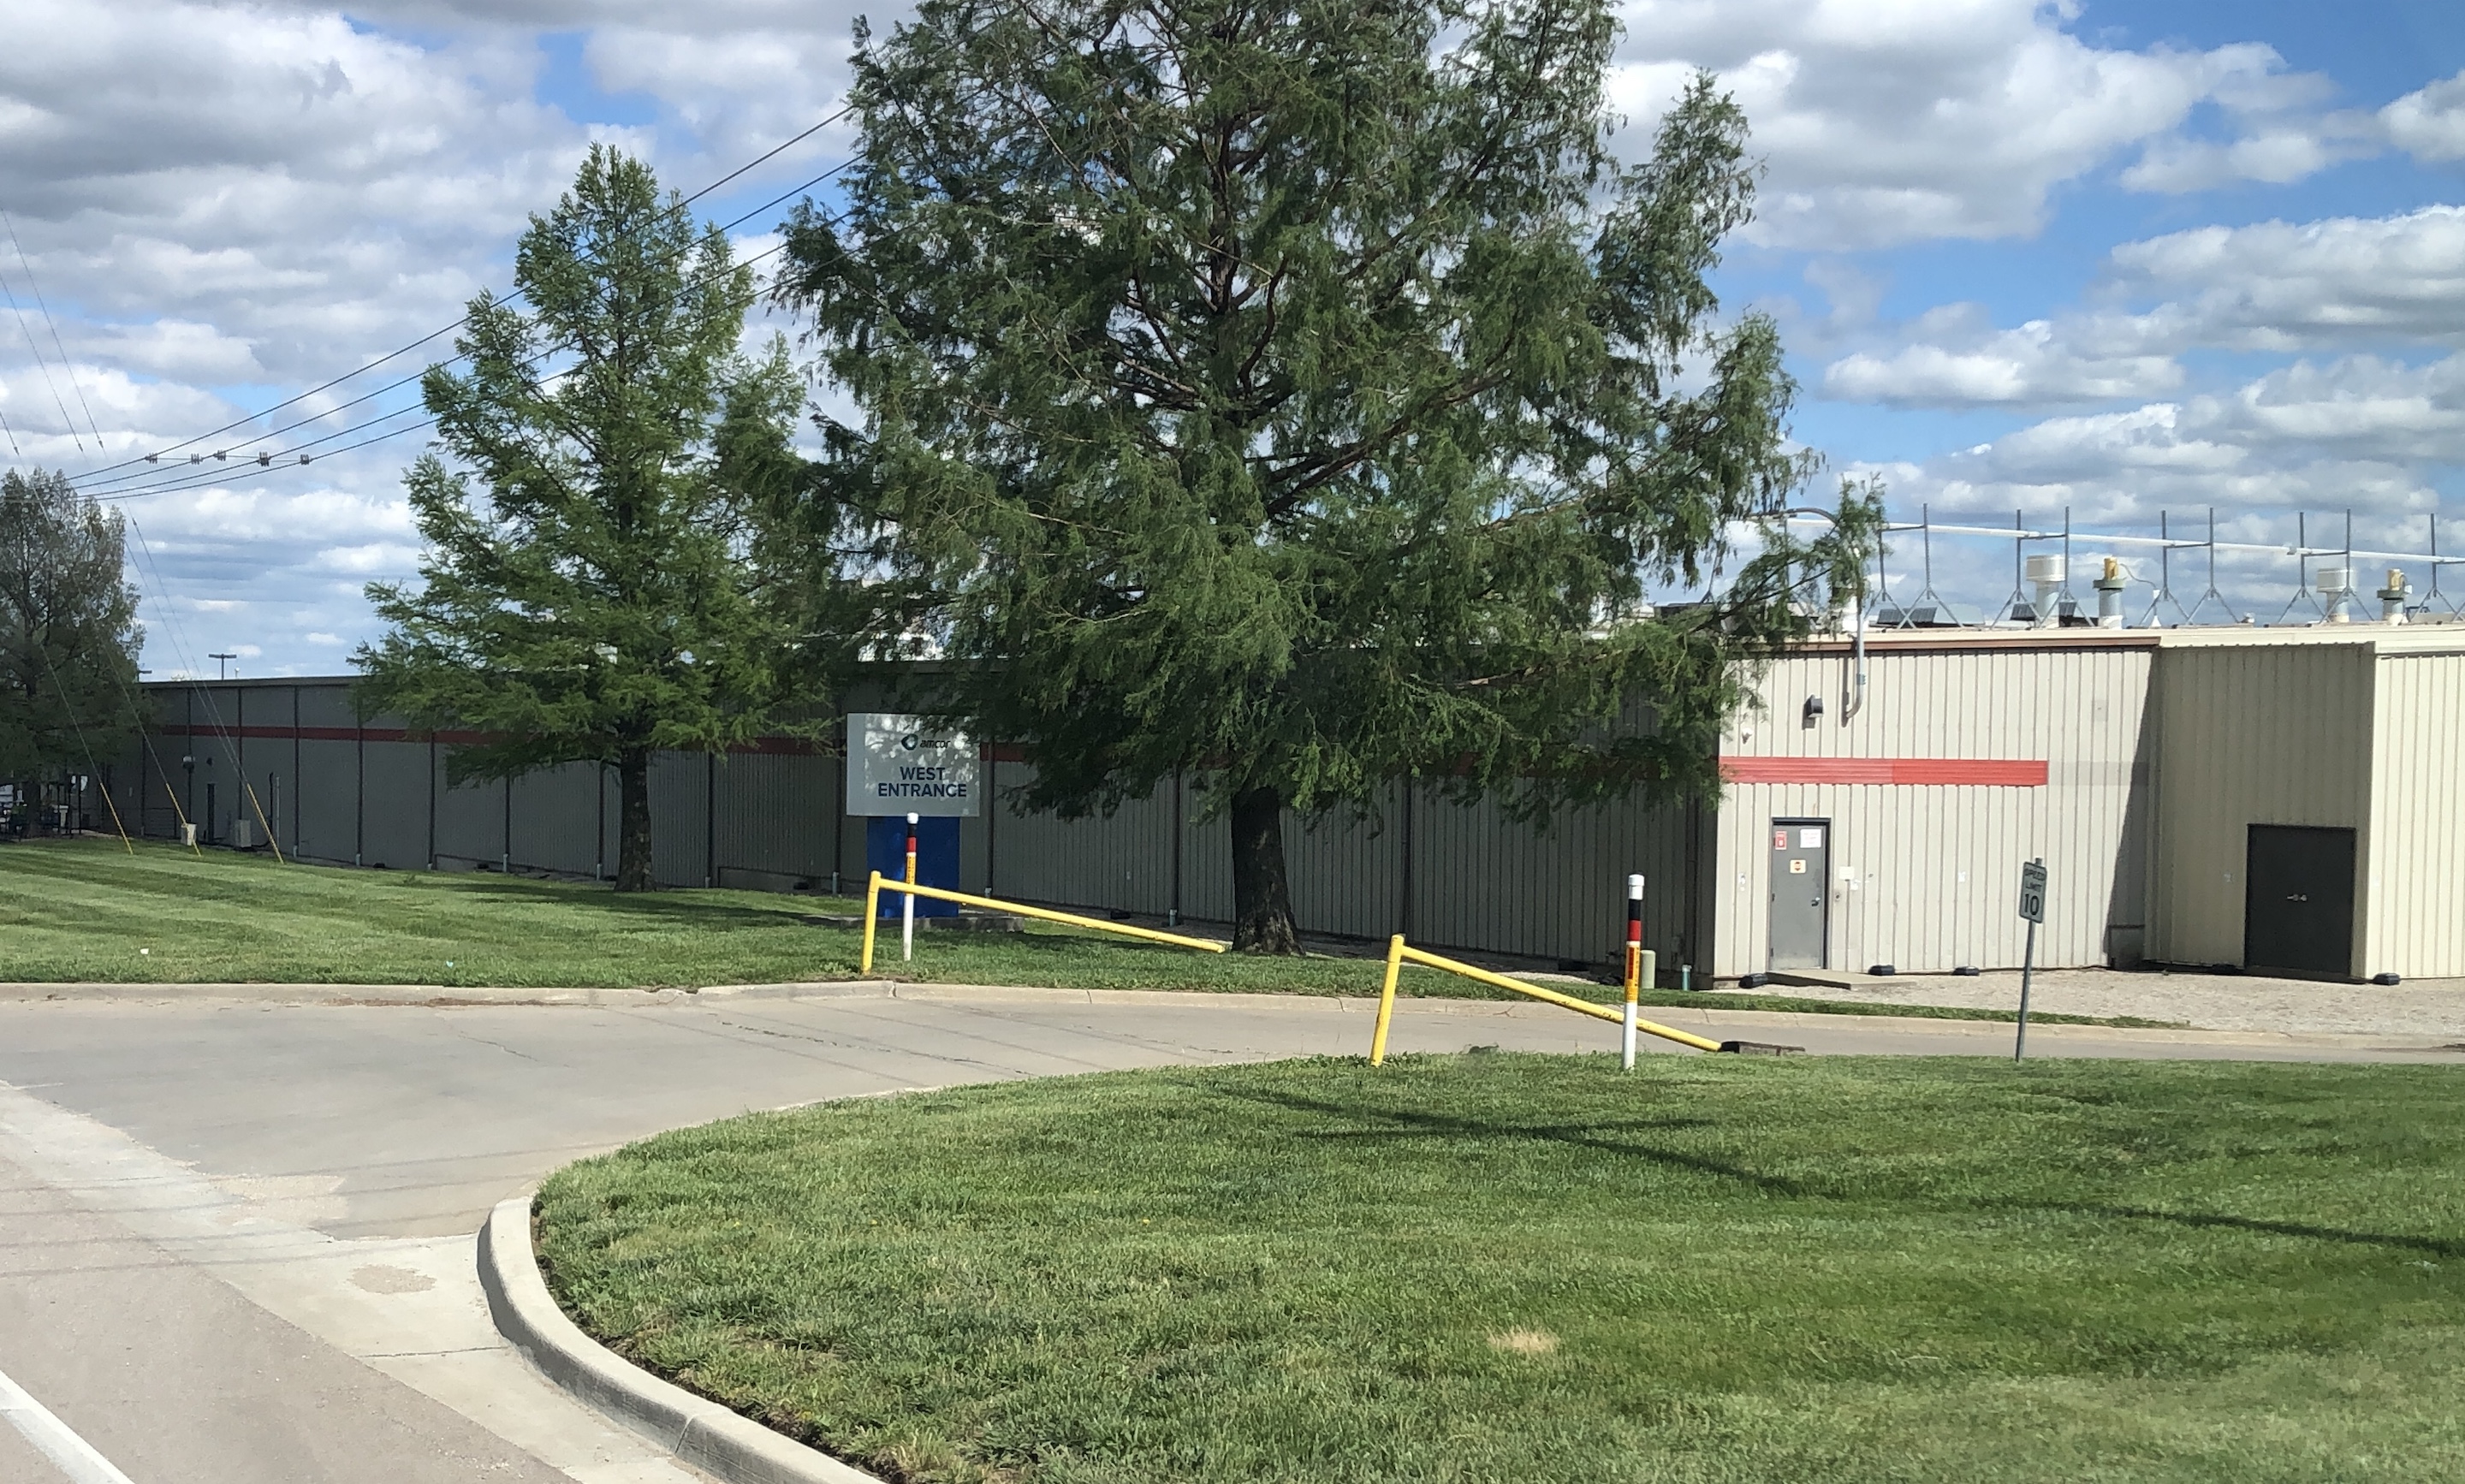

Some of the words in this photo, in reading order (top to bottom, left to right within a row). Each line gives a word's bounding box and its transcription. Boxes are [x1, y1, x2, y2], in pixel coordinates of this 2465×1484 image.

[919, 739, 951, 749] amcor
[900, 766, 946, 781] WEST
[878, 782, 967, 798] ENTRANCE
[2024, 893, 2040, 916] 10
